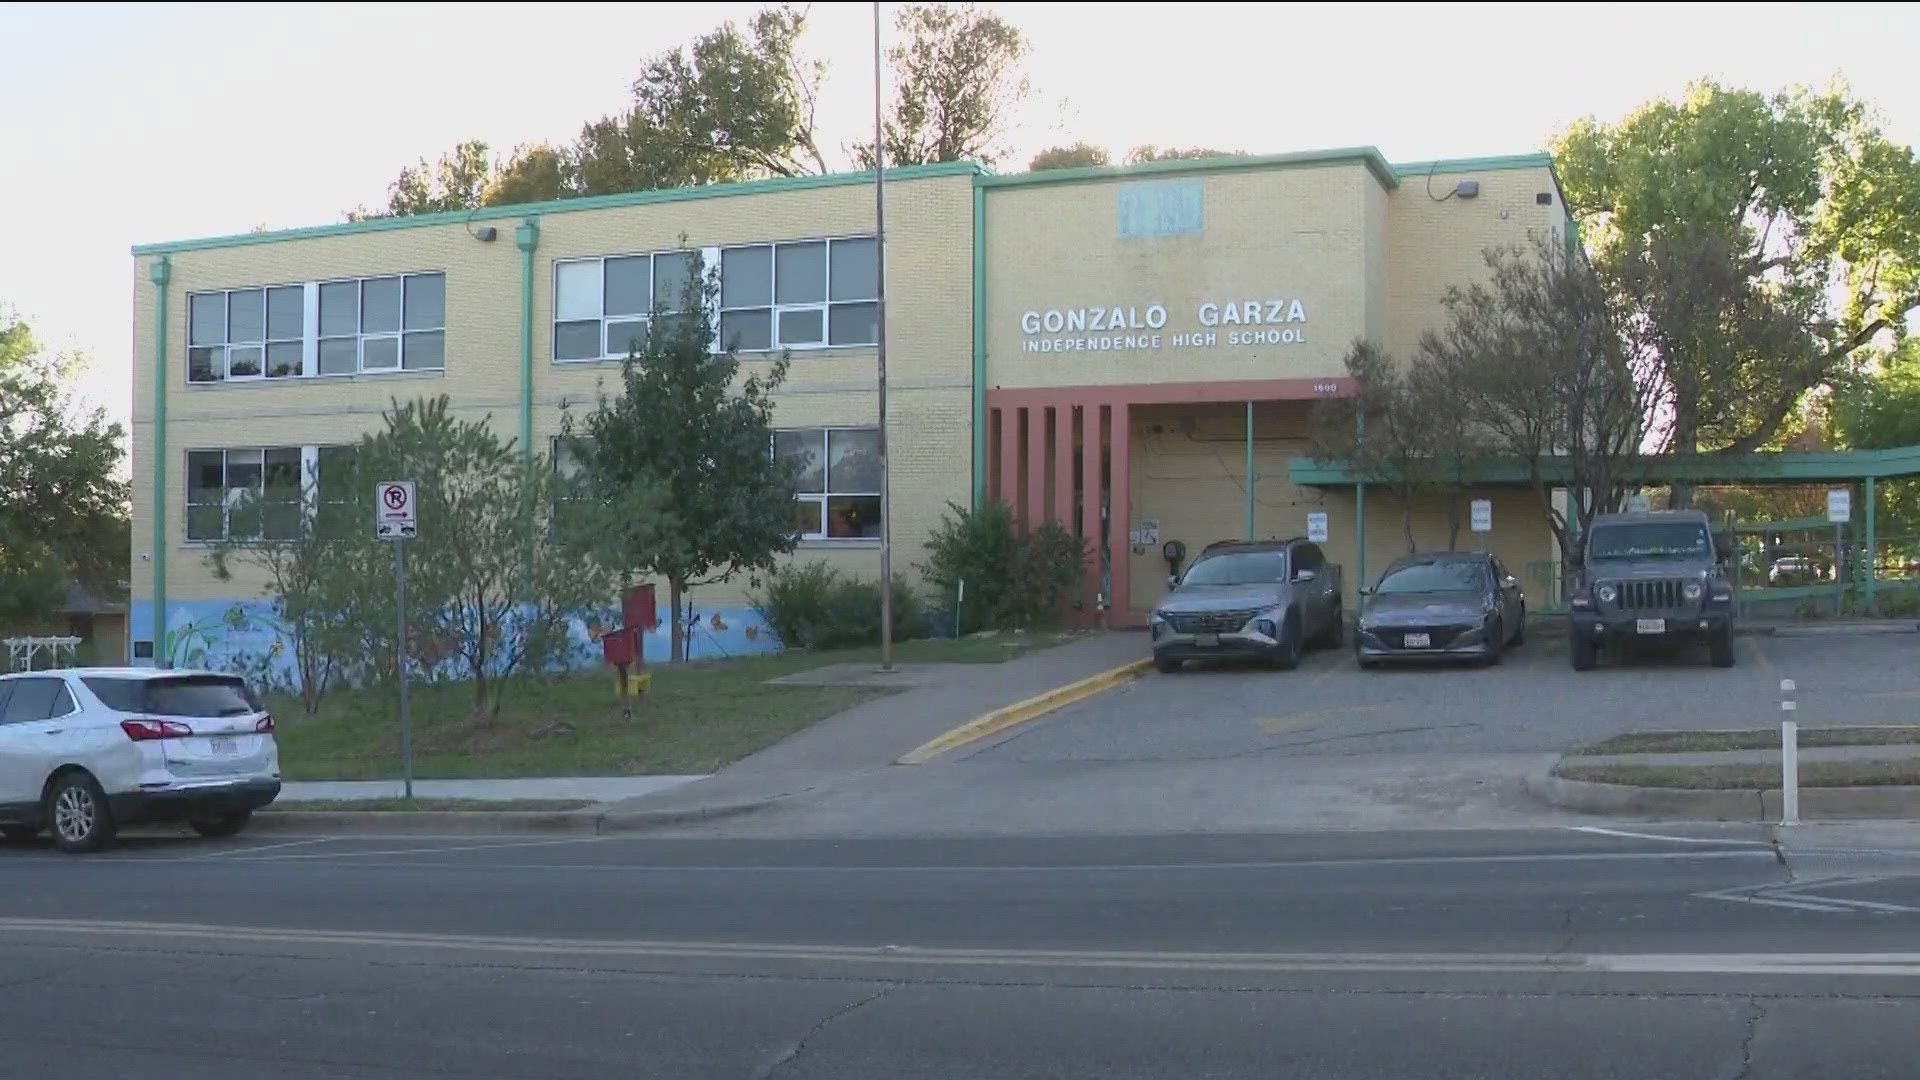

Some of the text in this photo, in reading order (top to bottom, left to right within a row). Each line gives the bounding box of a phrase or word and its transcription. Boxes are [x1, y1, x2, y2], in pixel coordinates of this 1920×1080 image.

[1021, 299, 1307, 335] GONZALO GARZA
[1022, 329, 1306, 352] INDEPENDENCE HIGH SCHOOL
